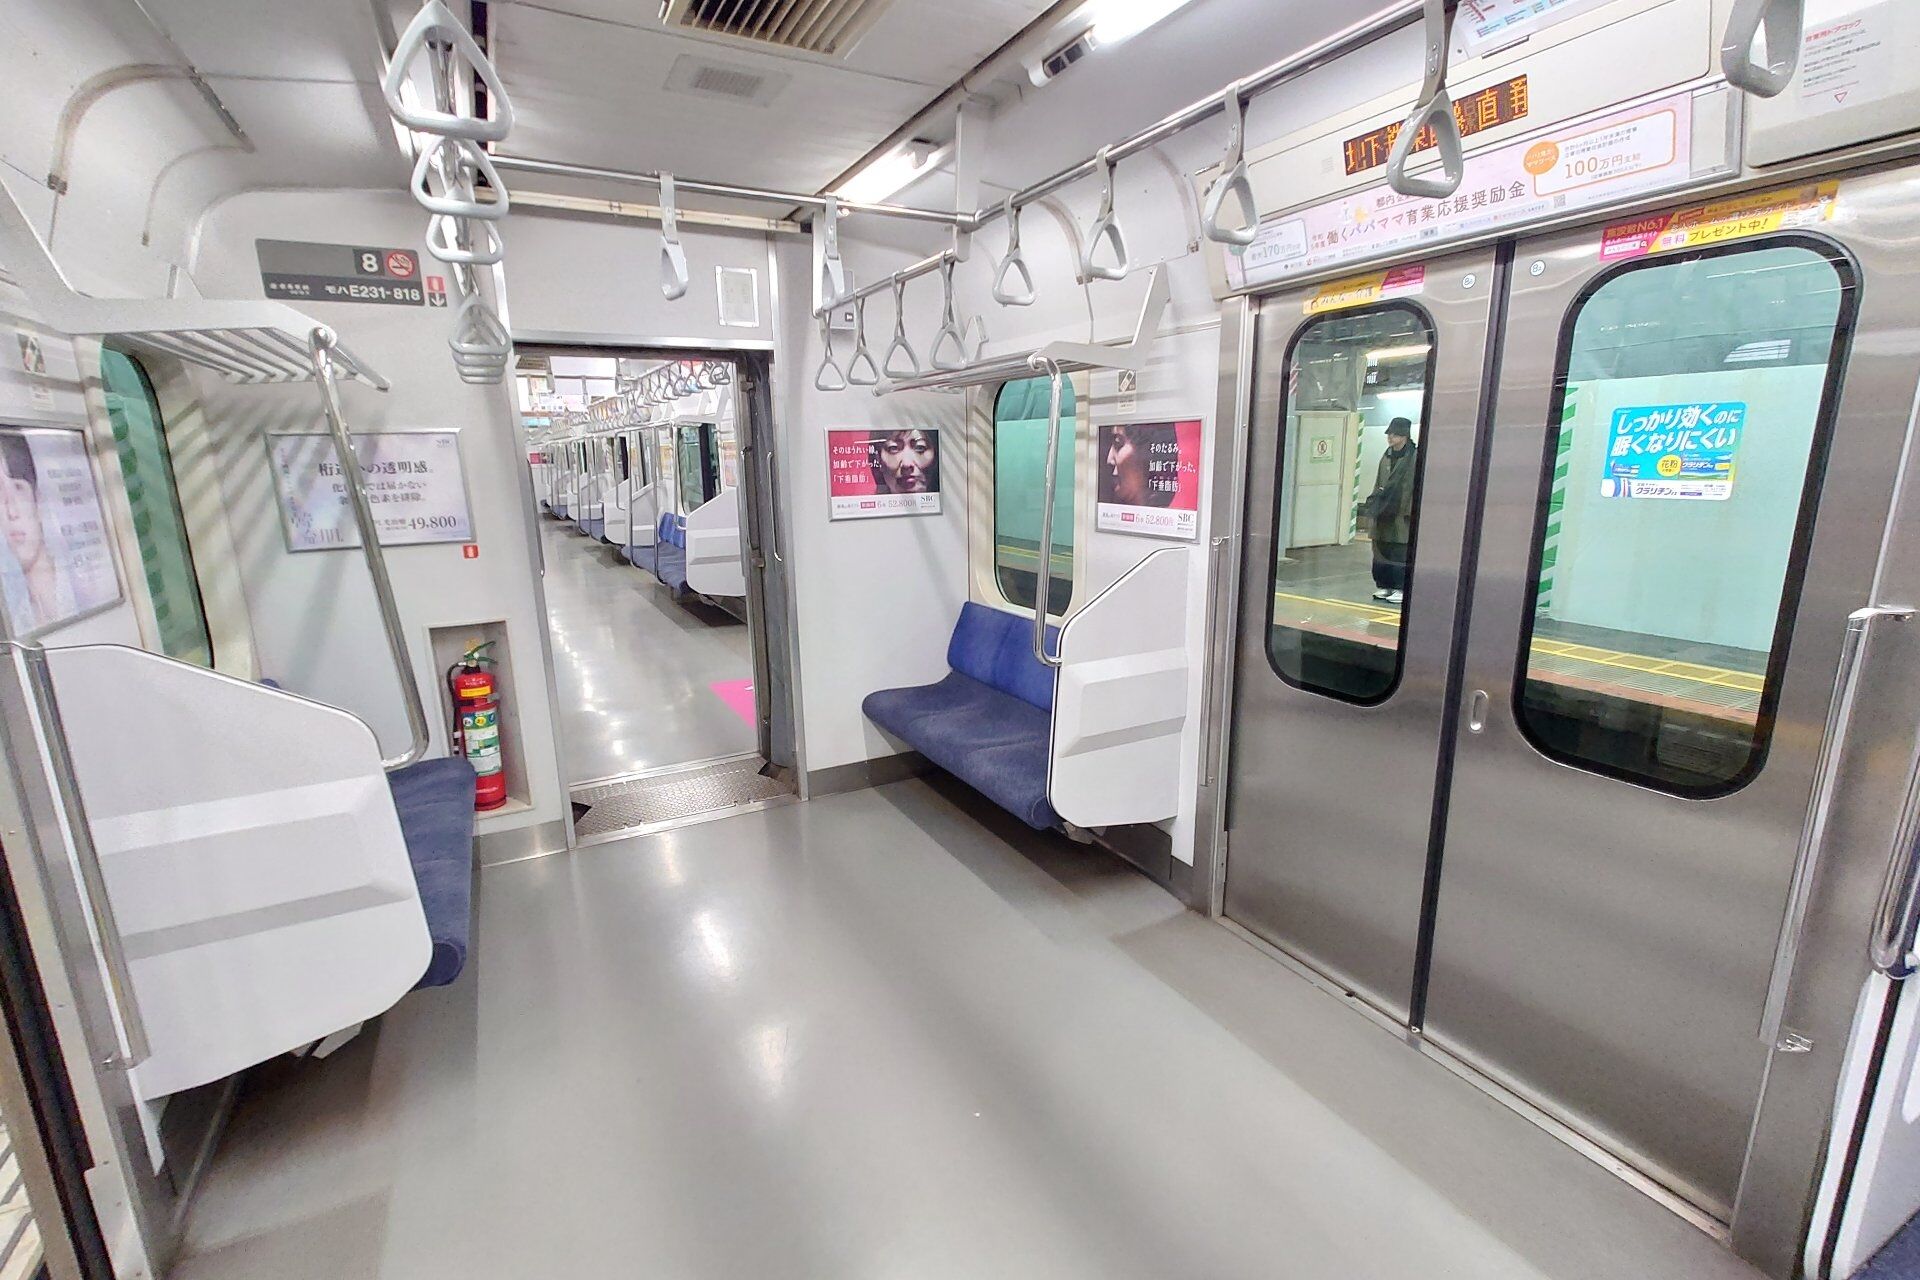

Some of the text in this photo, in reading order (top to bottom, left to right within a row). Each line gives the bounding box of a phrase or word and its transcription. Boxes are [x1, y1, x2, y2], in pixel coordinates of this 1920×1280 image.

[1326, 180, 1526, 245] 働くパパママ育業応援奨励金
[1689, 218, 1769, 242] プレゼント中!
[361, 253, 379, 273] 8
[1616, 405, 1742, 434] しっかり効くのに
[1150, 443, 1182, 454] そのたるみ。
[1610, 428, 1736, 457] 眠くなりにくい
[319, 460, 434, 477] 桁の透明感。
[1661, 459, 1678, 469] 花粉
[333, 480, 428, 493] 化では届かない
